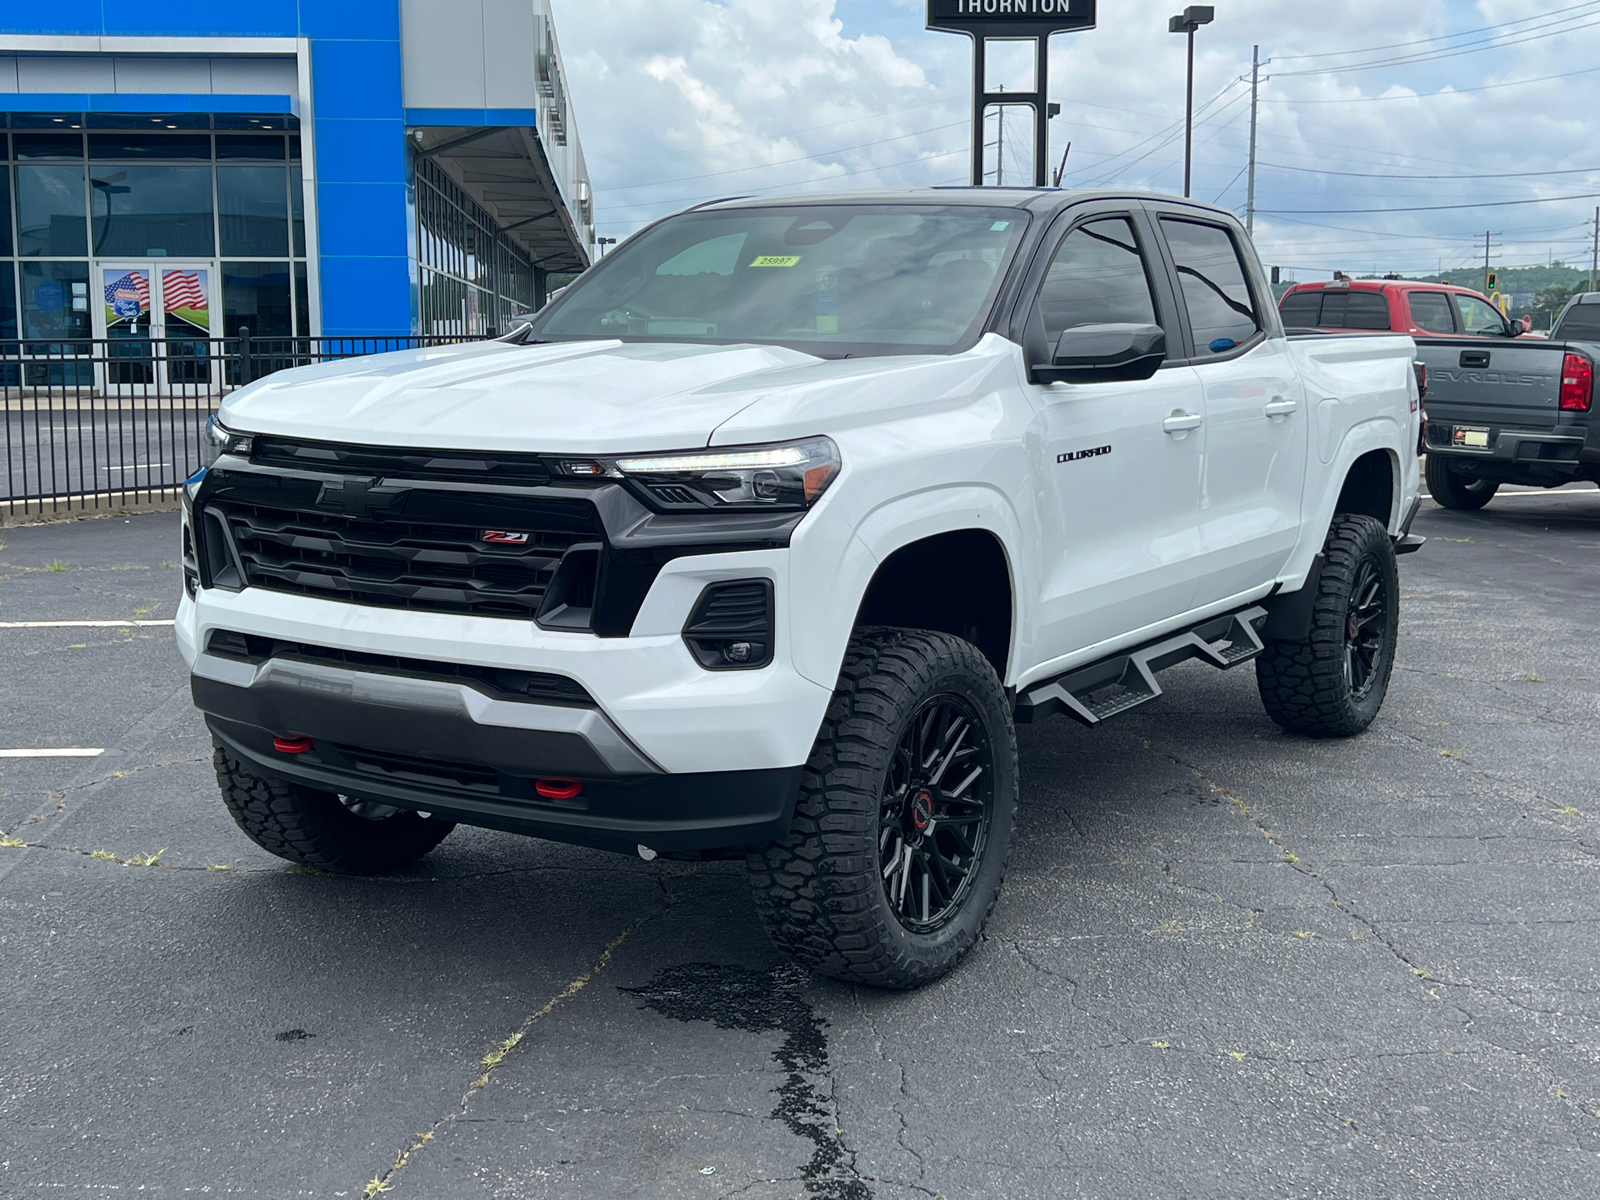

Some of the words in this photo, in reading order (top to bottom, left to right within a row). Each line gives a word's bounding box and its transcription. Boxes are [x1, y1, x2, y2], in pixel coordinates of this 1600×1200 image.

[956, 0, 1070, 13] THORNTON
[759, 257, 792, 265] 25997
[1427, 371, 1552, 386] EVROLET
[1056, 445, 1112, 463] COLORADO
[482, 530, 529, 544] Z71
